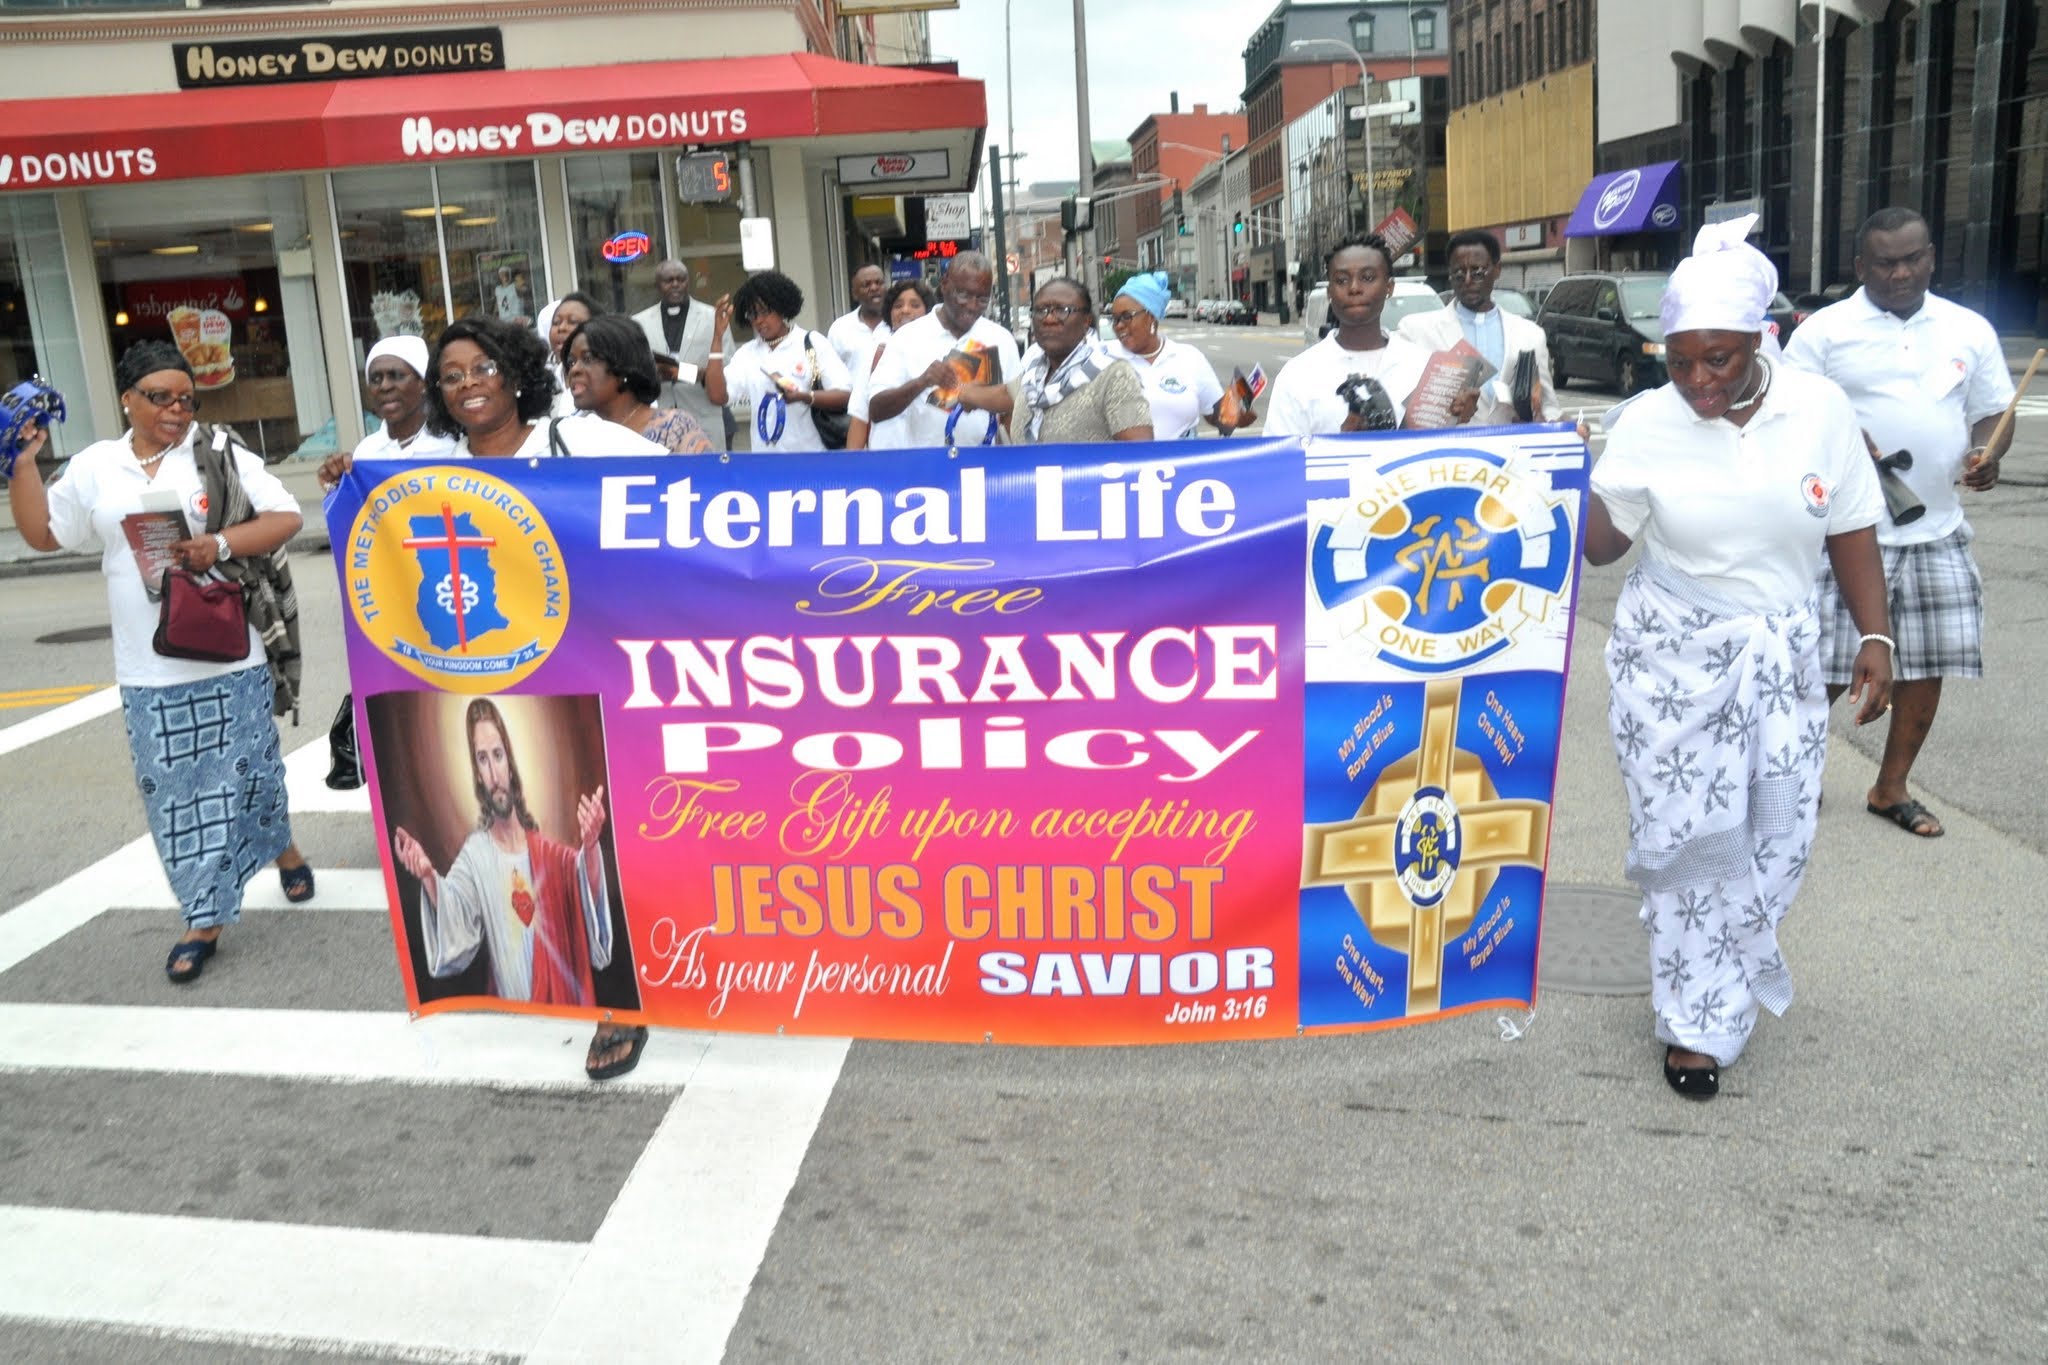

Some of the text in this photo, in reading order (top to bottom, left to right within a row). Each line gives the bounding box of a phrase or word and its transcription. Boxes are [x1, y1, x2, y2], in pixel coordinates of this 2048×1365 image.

[186, 42, 494, 80] HONEY DEW DONUTS
[401, 108, 747, 155] HONEY DEW DONUTS
[20, 147, 157, 183] DONUTS
[713, 161, 728, 192] 5
[602, 236, 649, 258] OPEN
[600, 462, 1236, 549] Eternal Life
[1357, 463, 1510, 518] ONE HEAR
[353, 475, 560, 623] THE METHODIST CHURCH GHANA
[795, 556, 1044, 617] Free
[424, 656, 509, 671] YOUR KINGDOM COME
[1379, 617, 1506, 658] ONE WAY
[614, 624, 1277, 709] INSURANCE
[1338, 694, 1393, 762] My Blood is
[1478, 712, 1495, 740] One
[1486, 690, 1503, 717] One
[661, 716, 1263, 782] Policy
[1347, 721, 1395, 782] Royal Blue
[639, 769, 1258, 867] Free Gift upon accepting
[711, 863, 1225, 942] JESUS CHRIST
[1463, 895, 1511, 956] My Blood is
[641, 917, 1274, 1019] As your personal SAVIOR
[1336, 954, 1353, 985] One
[1343, 933, 1360, 965] One
[1470, 918, 1514, 970] Royal Blue
[1164, 996, 1267, 1025] John 3:16
